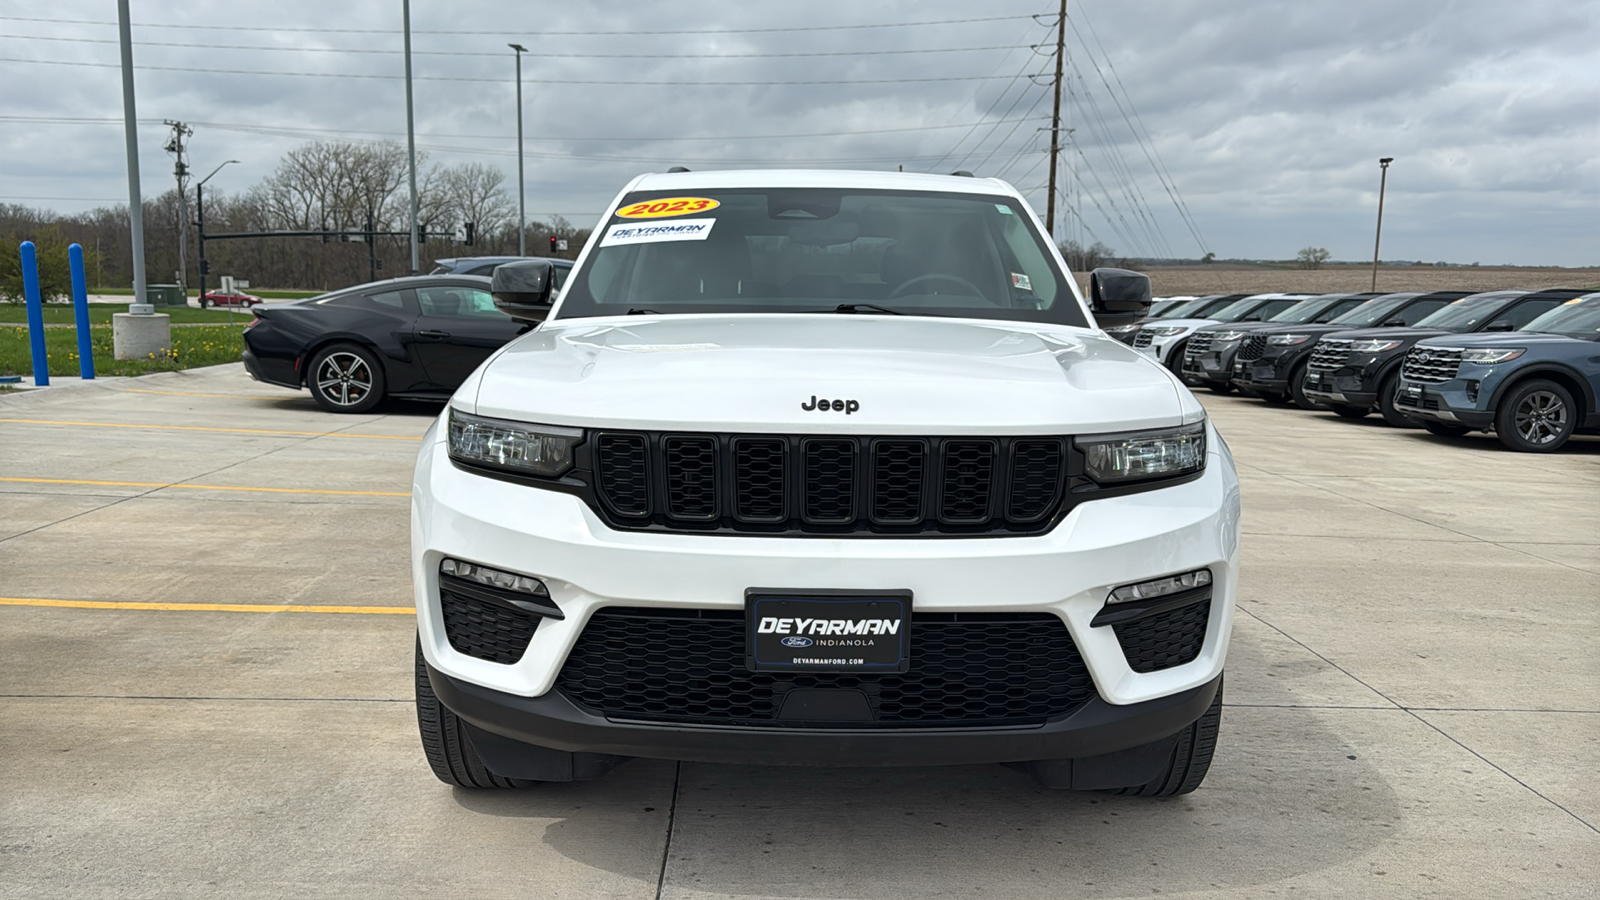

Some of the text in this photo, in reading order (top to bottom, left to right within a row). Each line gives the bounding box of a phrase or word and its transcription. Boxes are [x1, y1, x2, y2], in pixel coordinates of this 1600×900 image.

[625, 200, 710, 216] 2023
[612, 224, 706, 237] DEYARMAN
[801, 395, 859, 415] Jeep
[757, 617, 901, 635] DEYARMAN
[786, 637, 875, 647] Ford INDIANOLA
[793, 657, 864, 665] DEYARMANFORD.COM
